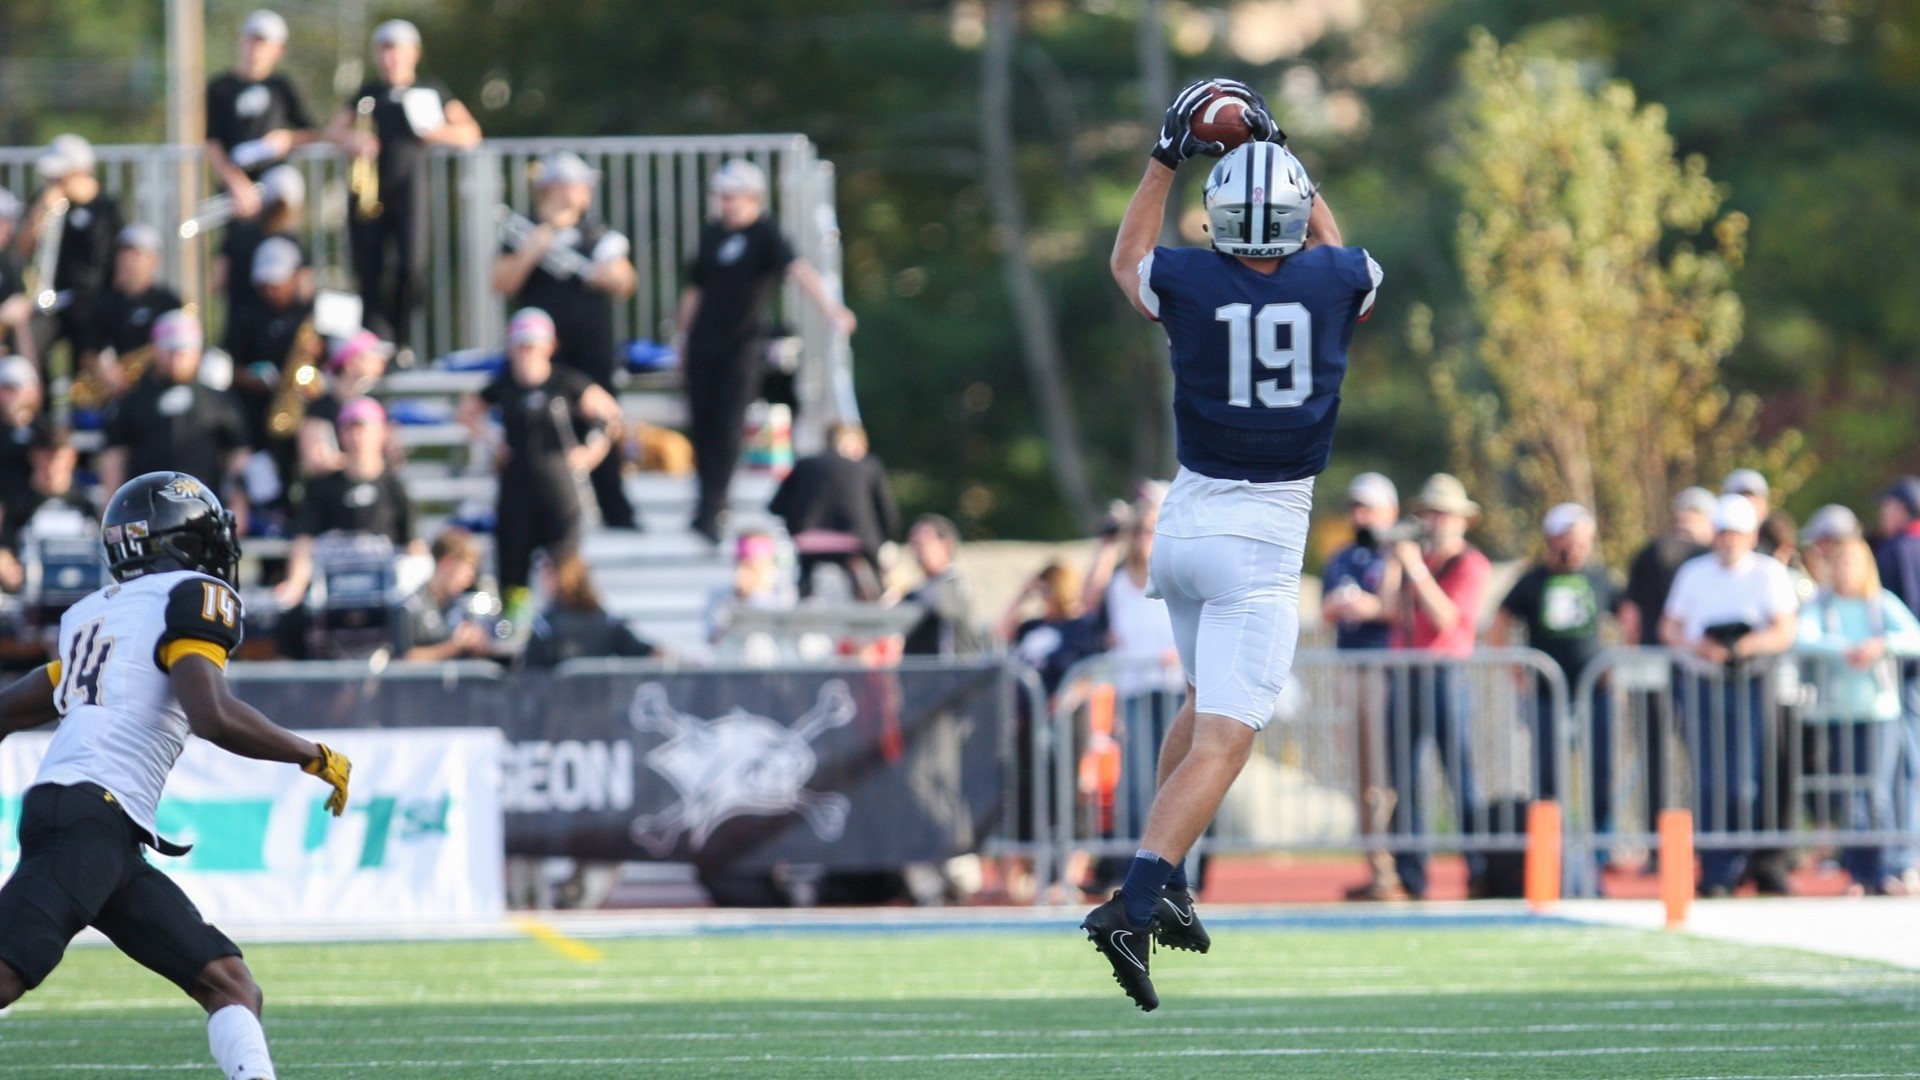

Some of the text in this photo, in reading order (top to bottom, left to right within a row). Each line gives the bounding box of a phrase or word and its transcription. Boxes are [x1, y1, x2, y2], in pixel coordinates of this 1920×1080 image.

[1232, 247, 1284, 256] WILDCATS
[1215, 302, 1313, 408] 19
[201, 581, 236, 628] 14
[62, 617, 114, 711] 14
